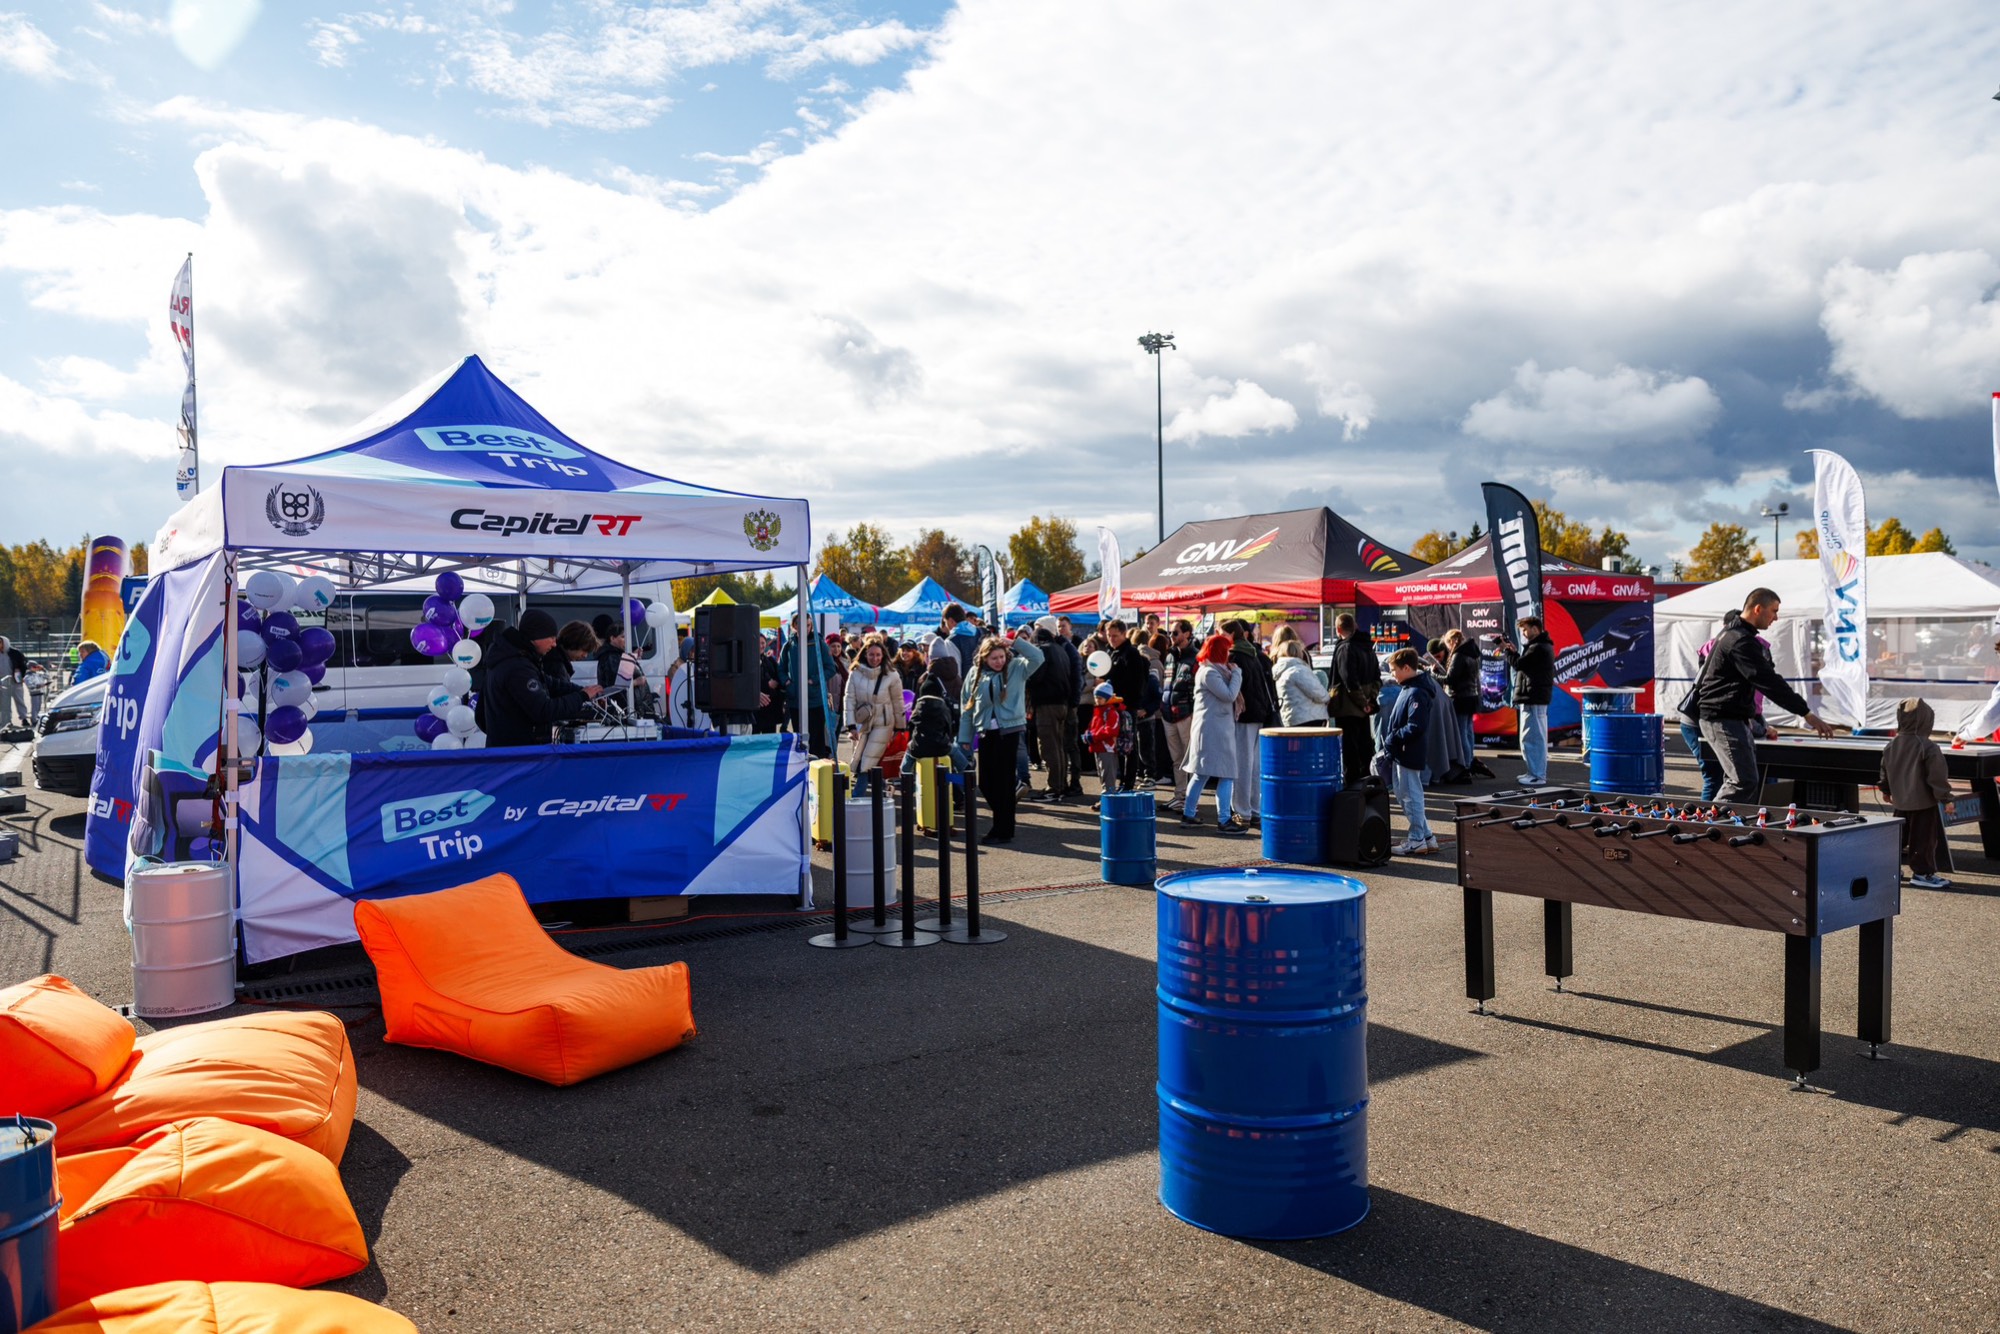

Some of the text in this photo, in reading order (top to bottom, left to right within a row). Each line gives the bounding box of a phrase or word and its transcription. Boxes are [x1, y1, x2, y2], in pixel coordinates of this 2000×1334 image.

[436, 430, 555, 454] Best
[488, 452, 589, 477] Trip
[450, 507, 643, 537] CapitalRT
[1176, 538, 1255, 564] GNV
[1130, 589, 1205, 602] GRAND NEW VISION
[1395, 582, 1468, 594] МОТОРНЫЕ МАСЛА
[1568, 584, 1591, 596] GNV
[1612, 585, 1634, 597] GNV
[1466, 619, 1498, 629] RACING
[1472, 608, 1490, 617] GNV
[1553, 640, 1605, 671] ТЕХНОЛОГИЯ
[1557, 658, 1589, 684] КАЖДОЙ
[1588, 647, 1618, 668] КАПЛЕ
[104, 684, 138, 741] rip
[394, 798, 469, 833] Best
[503, 793, 688, 821] by CapitalRT
[419, 830, 484, 860] Trip
